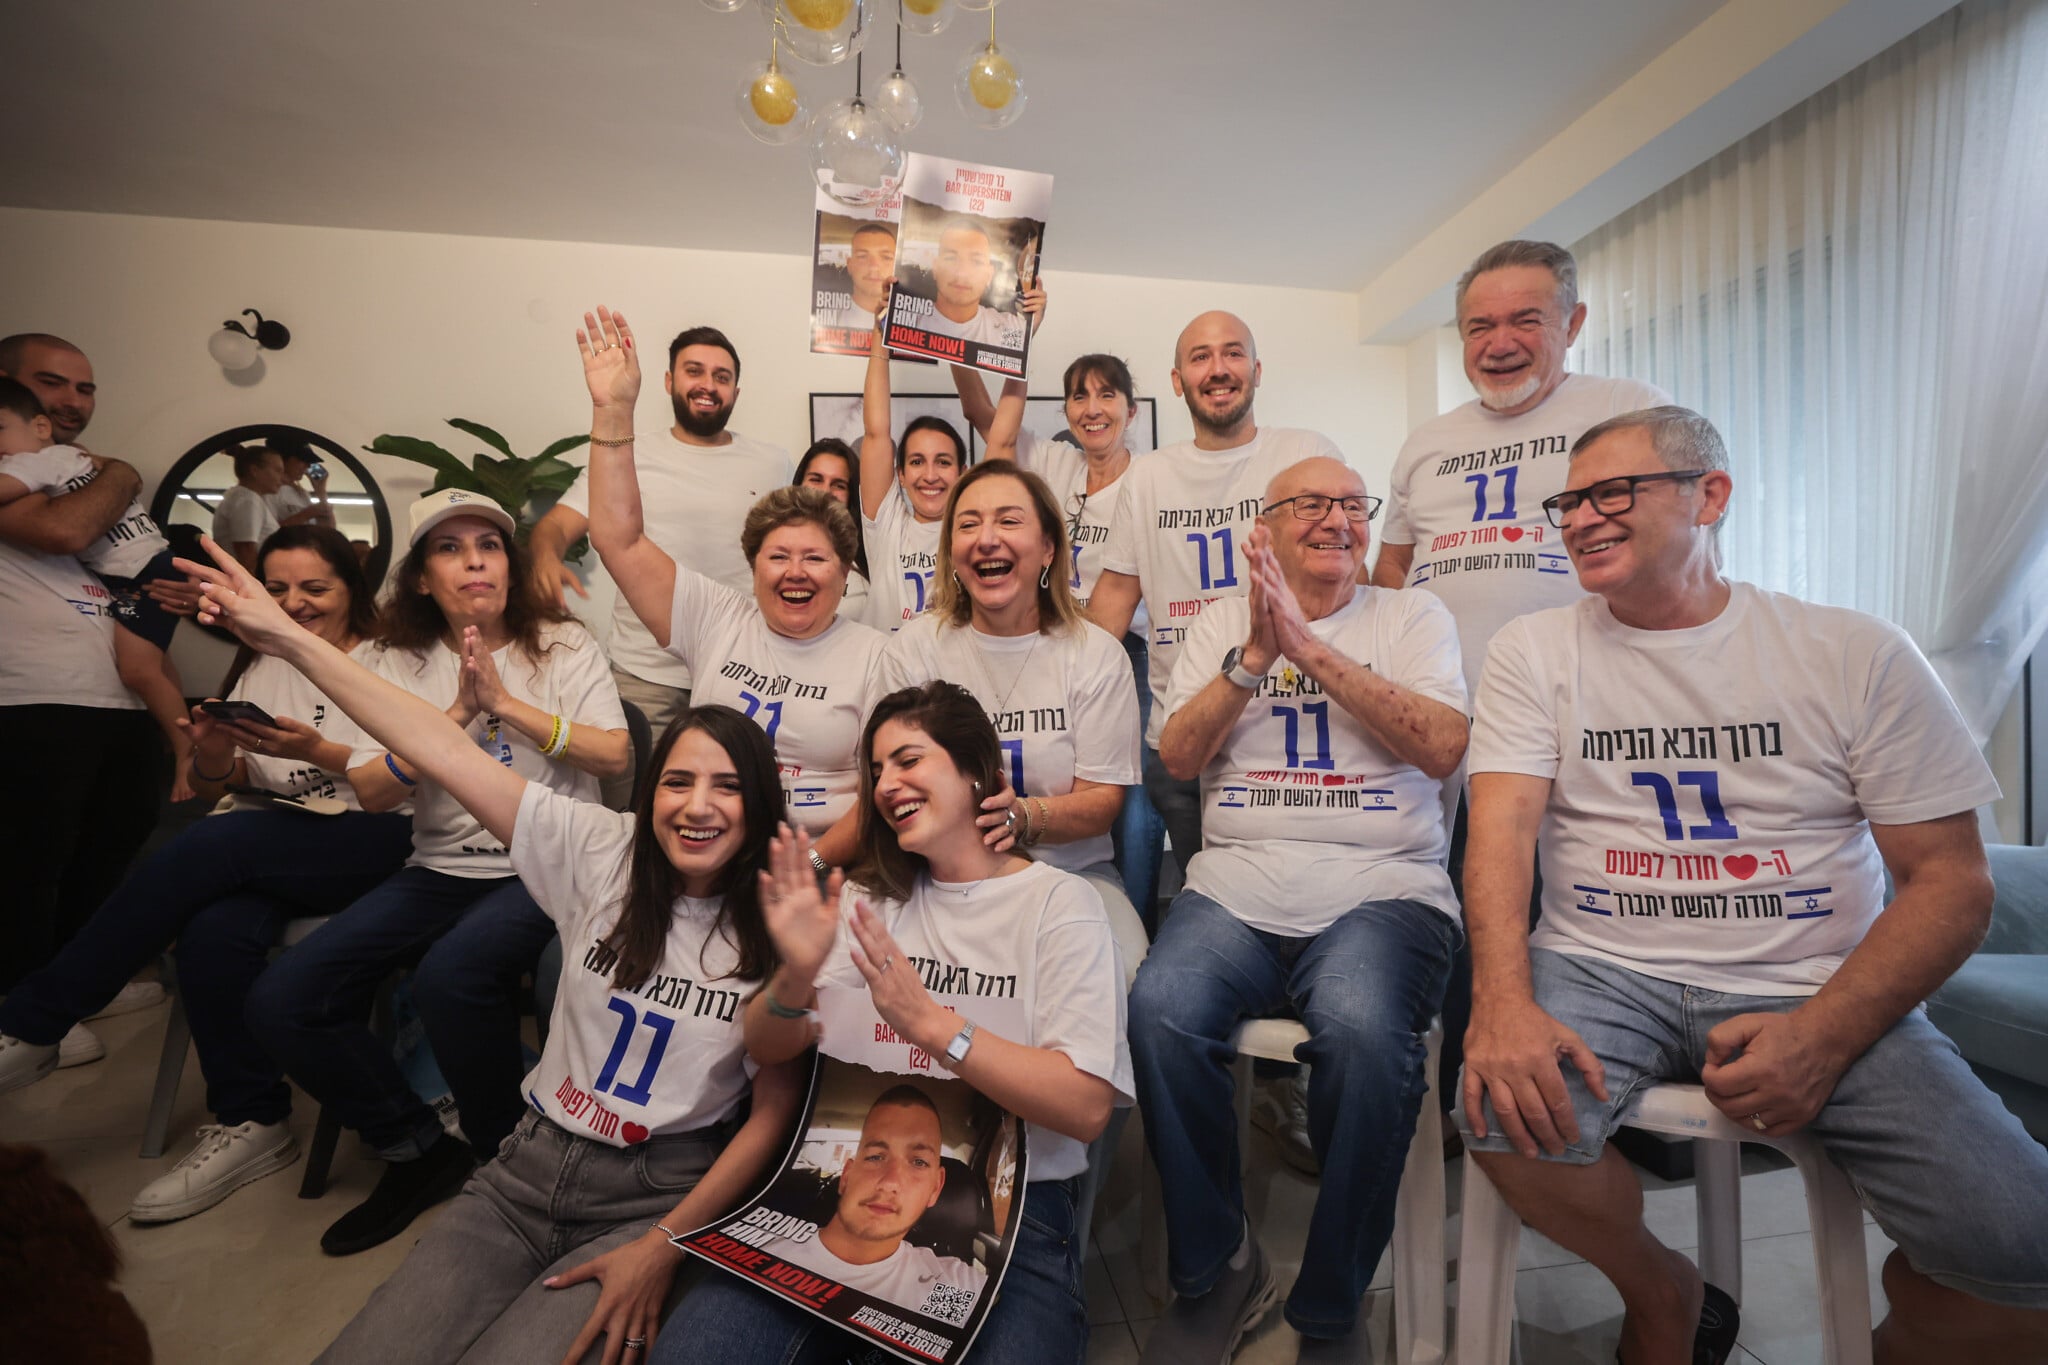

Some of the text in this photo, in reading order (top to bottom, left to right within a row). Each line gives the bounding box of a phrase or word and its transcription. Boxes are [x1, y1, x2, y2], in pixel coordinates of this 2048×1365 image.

[945, 180, 1012, 202] BAR KUPERSHTEIN
[969, 198, 984, 212] (22)
[816, 291, 851, 309] BRING
[895, 293, 933, 316] BRING
[816, 308, 838, 326] HIM
[892, 308, 917, 328] HIM
[815, 328, 873, 349] HOME NOW
[890, 326, 927, 347] HOME
[929, 334, 966, 357] NOW!
[1436, 435, 1567, 476] ברוך הבא הביתה
[1464, 465, 1518, 522] בר
[1158, 510, 1203, 528] הביתה
[1431, 530, 1466, 553] לפעום
[1470, 526, 1498, 545] חוזר
[1187, 528, 1238, 590] בר
[1432, 553, 1535, 578] תודה להשם יתברך
[1169, 599, 1201, 617] לפעום
[720, 661, 768, 692] הביתה
[794, 682, 828, 700] ברוך
[992, 708, 1066, 733] ברוך הבא
[1272, 701, 1334, 770] בר
[1582, 722, 1783, 762] ברוך הבא הביתה
[1250, 788, 1359, 808] תודה להשם יתברך
[1631, 771, 1739, 840] בר
[1605, 849, 1664, 878] לפעום
[1670, 854, 1718, 880] חוזר
[1613, 892, 1783, 918] תודה להשם יתברך
[644, 974, 740, 1023] ברוך הבא
[875, 1023, 896, 1043] BAR
[594, 996, 676, 1107] בר
[909, 1046, 931, 1071] (22)
[555, 1075, 620, 1139] חוזר לפעום
[719, 1221, 777, 1248] HIM
[741, 1206, 818, 1243] BRING
[696, 1232, 845, 1304] HOME NOW!
[850, 1311, 948, 1360] FAMILIES FORUM
[859, 1305, 953, 1349] HOSTAGES AND MISSING
